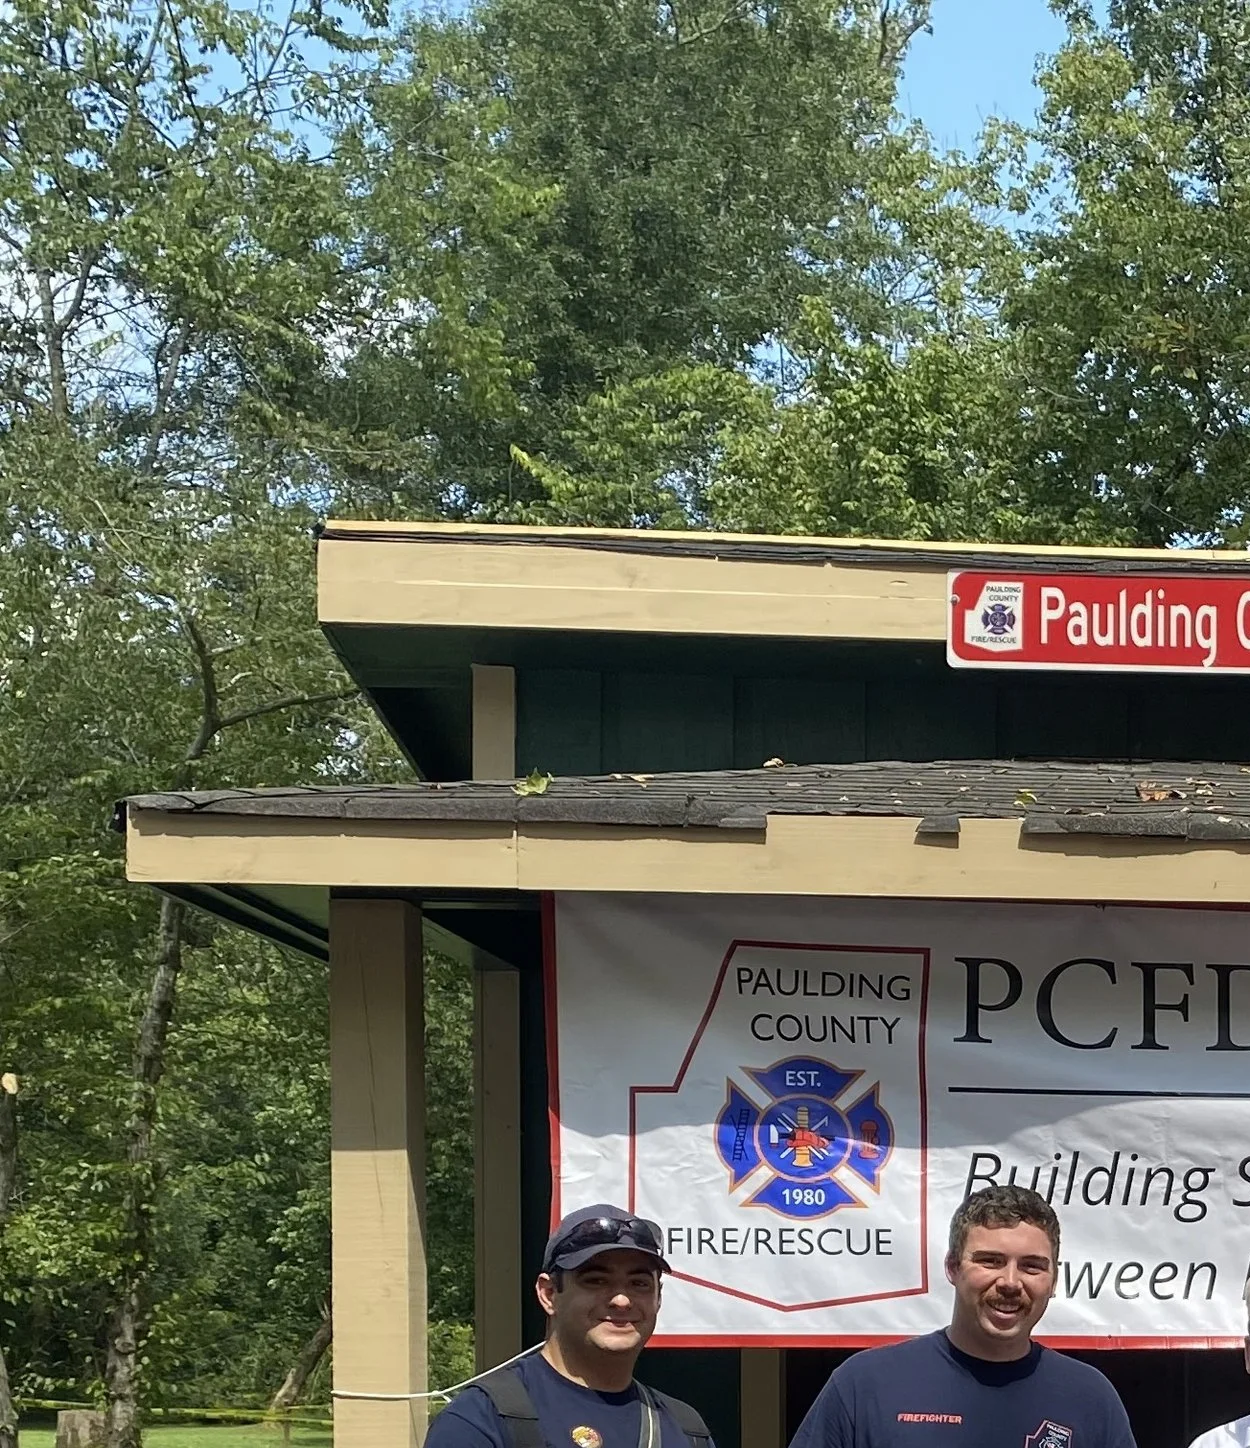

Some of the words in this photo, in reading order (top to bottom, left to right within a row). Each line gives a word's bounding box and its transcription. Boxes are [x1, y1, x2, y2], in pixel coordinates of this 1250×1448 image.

[1039, 586, 1218, 668] Paulding
[736, 966, 912, 1001] PAULDING
[750, 1013, 901, 1045] COUNTY
[785, 1070, 821, 1087] EST.
[782, 1189, 826, 1206] 1980
[963, 1150, 1216, 1223] Building
[667, 1227, 893, 1257] FIRE/RESCUE
[1055, 1261, 1217, 1300] ween
[897, 1413, 962, 1425] FIREFIGHTER
